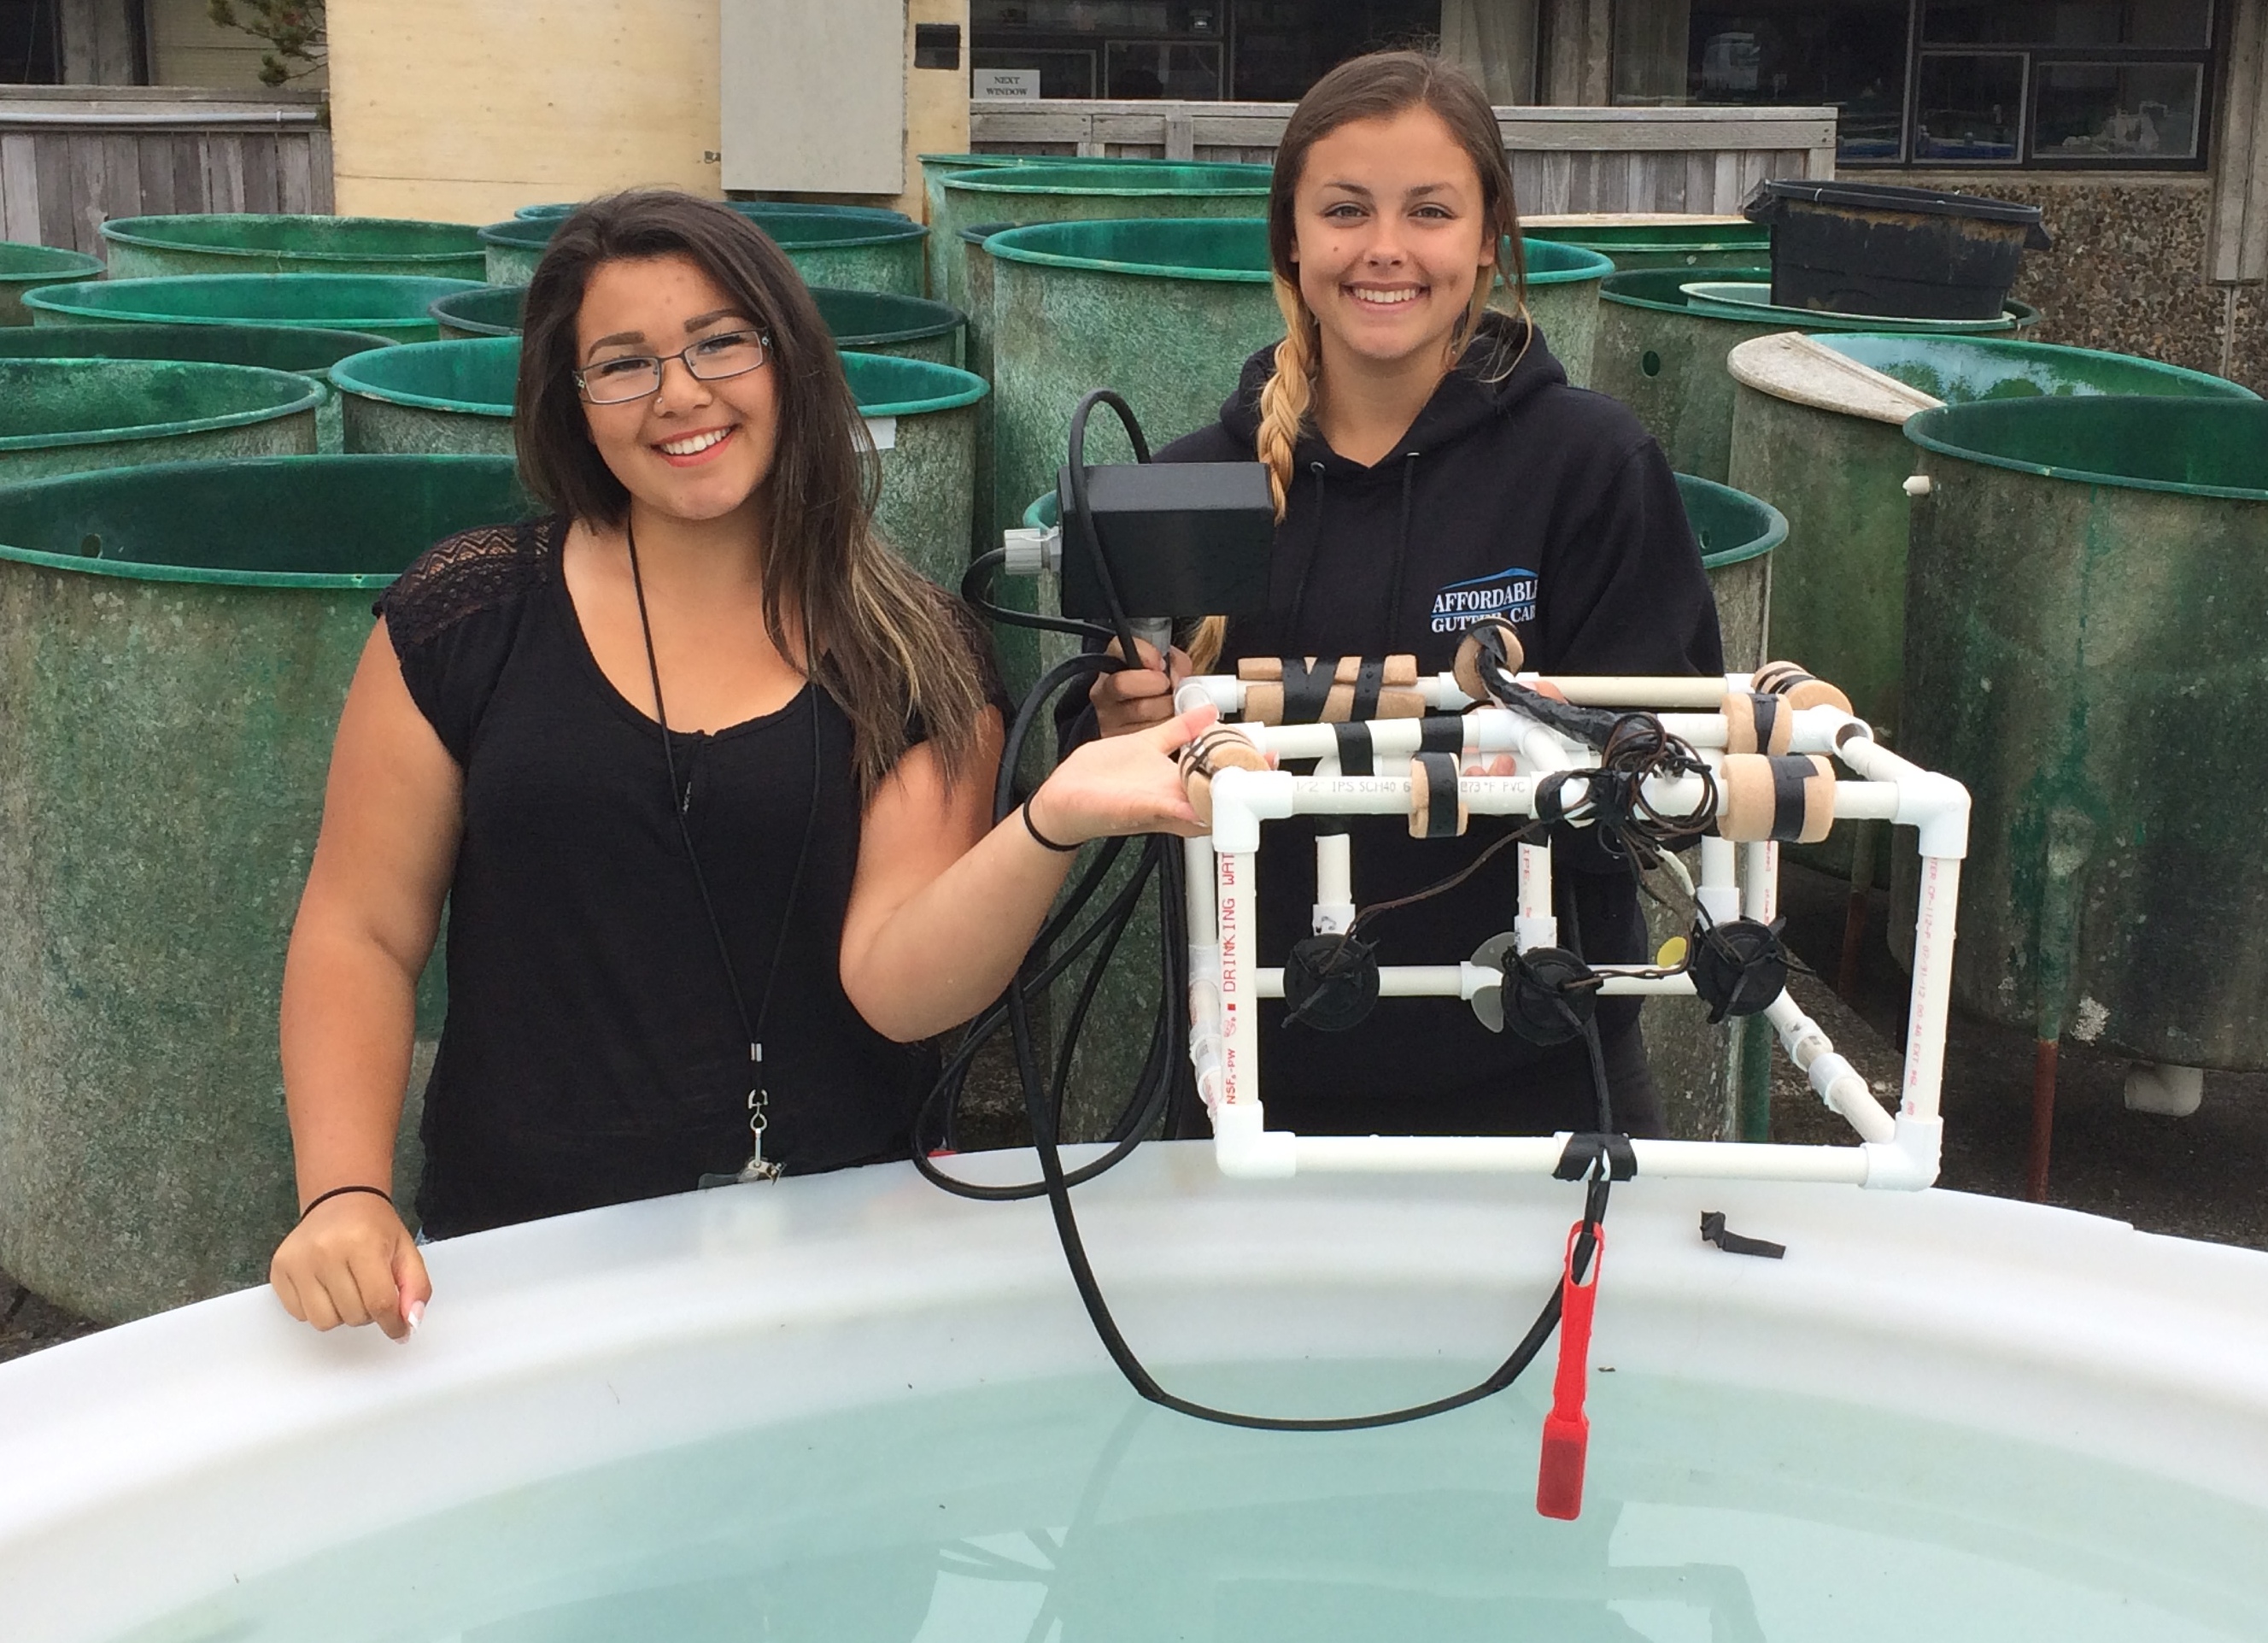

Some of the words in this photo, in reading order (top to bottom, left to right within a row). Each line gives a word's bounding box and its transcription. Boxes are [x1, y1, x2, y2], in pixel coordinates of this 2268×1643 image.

[993, 76, 1021, 85] NEXT
[986, 87, 1029, 96] WINDOW
[1333, 780, 1355, 793] IPS
[1359, 780, 1396, 793] SCH40
[1503, 781, 1526, 793] PVC
[1222, 898, 1236, 993] DRINKING
